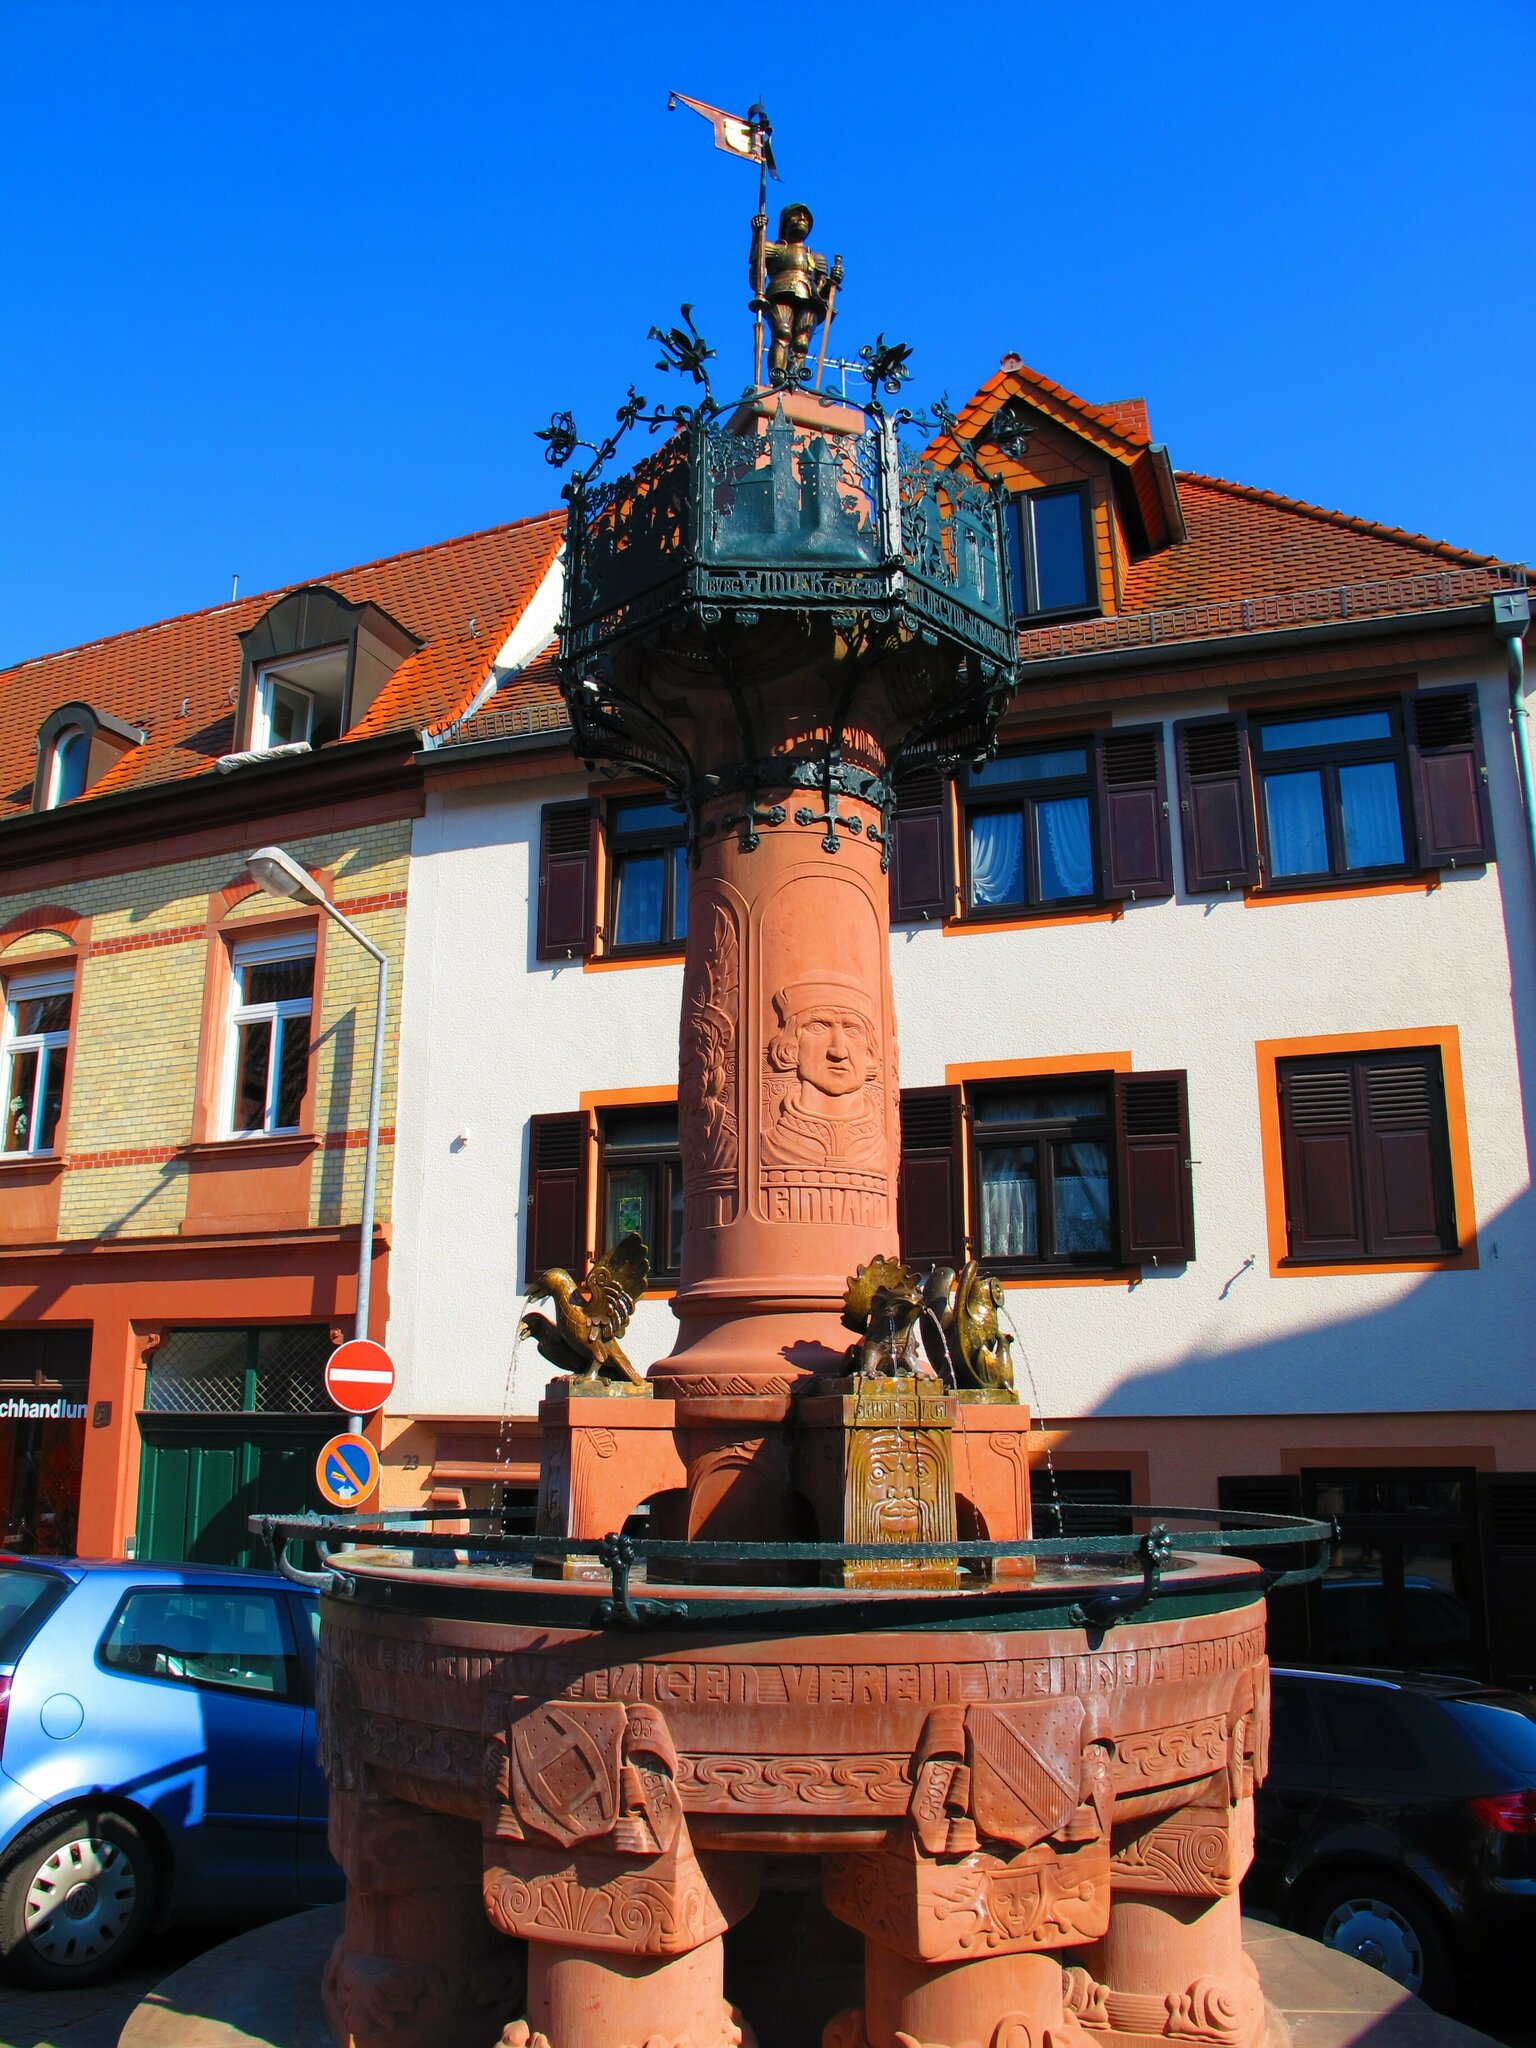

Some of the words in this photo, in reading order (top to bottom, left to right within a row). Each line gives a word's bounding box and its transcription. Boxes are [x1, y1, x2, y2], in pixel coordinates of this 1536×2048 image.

[0, 1398, 88, 1419] chhandlun
[402, 1454, 420, 1471] 23
[783, 1661, 961, 1705] VEREIN
